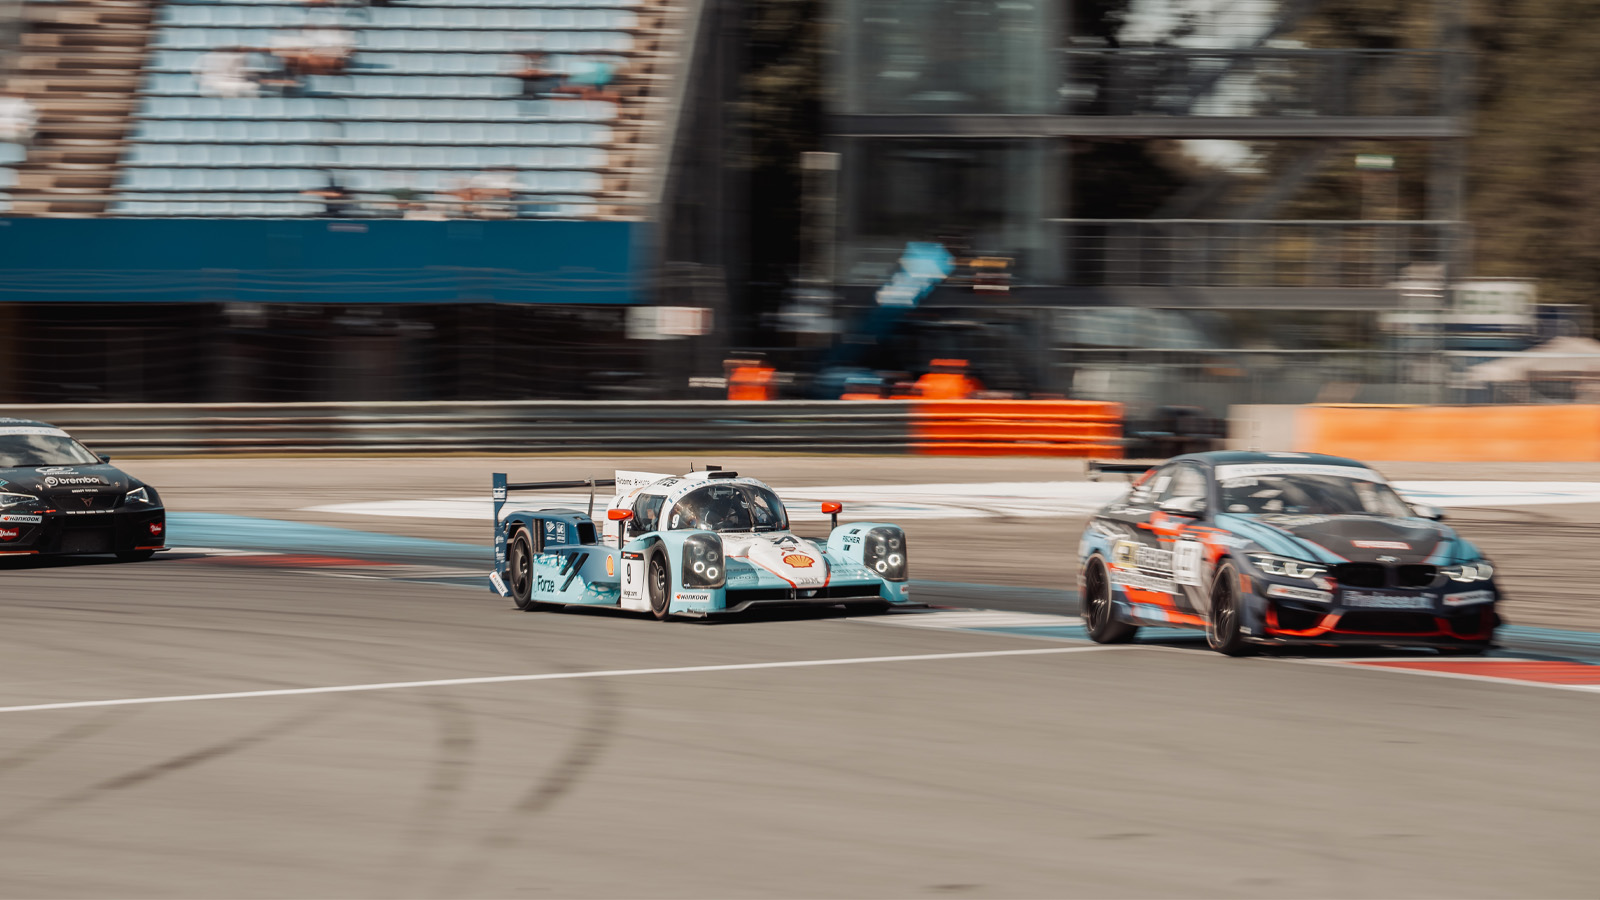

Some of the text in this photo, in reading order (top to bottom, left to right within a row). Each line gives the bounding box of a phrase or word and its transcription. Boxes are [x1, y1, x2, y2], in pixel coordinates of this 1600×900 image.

[58, 477, 99, 485] brembo
[671, 514, 680, 529] 9
[626, 562, 632, 585] 9
[537, 575, 555, 593] Forze
